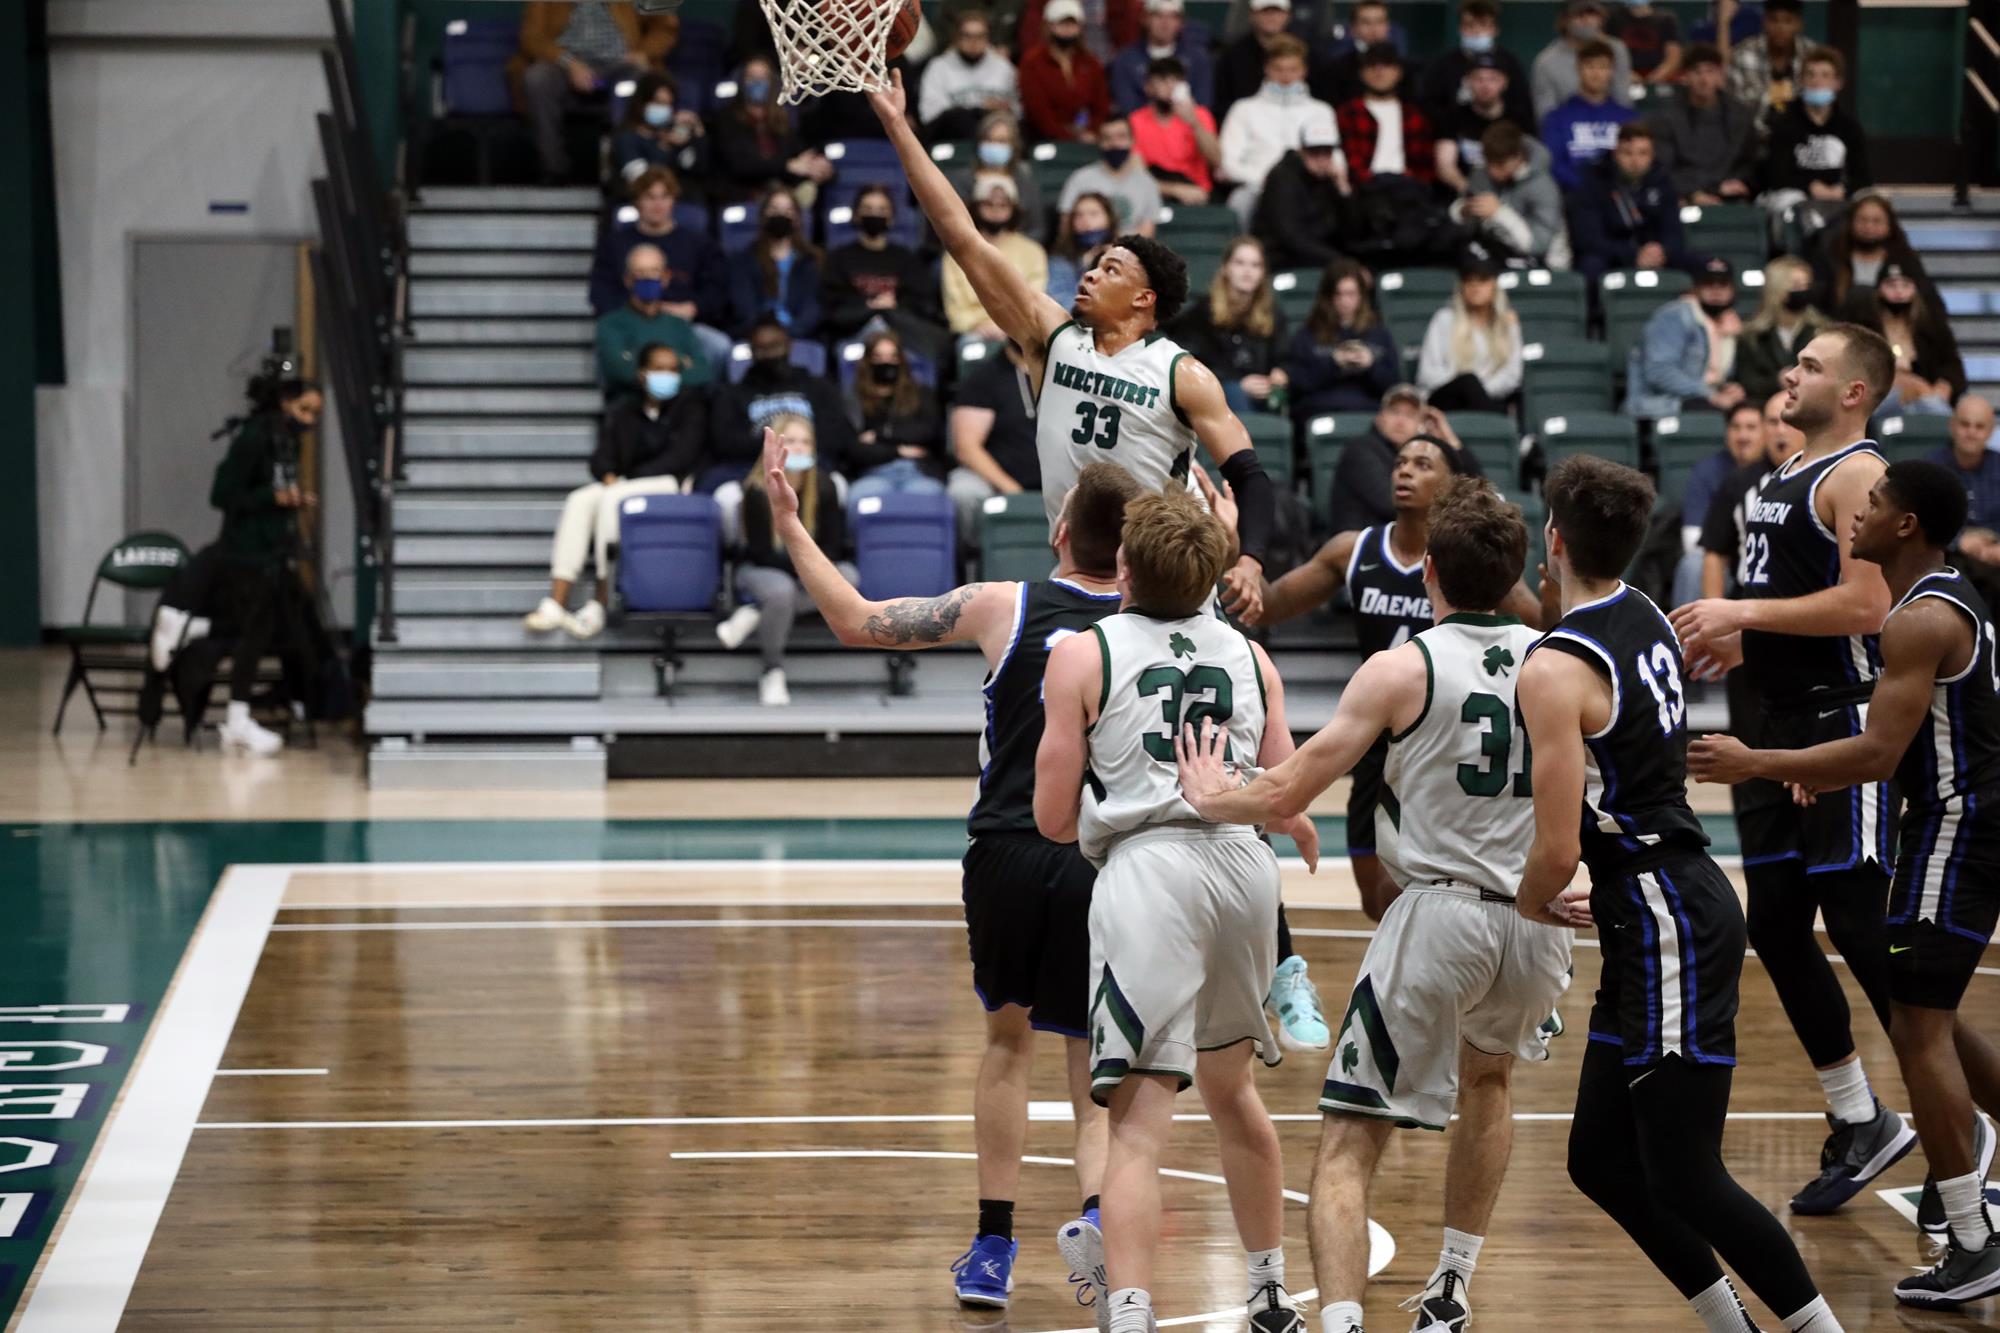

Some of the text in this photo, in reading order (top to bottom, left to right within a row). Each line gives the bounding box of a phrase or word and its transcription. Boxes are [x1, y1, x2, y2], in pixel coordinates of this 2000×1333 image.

[1053, 361, 1160, 409] MERCYHURST
[1071, 401, 1121, 449] 33
[1745, 532, 1769, 583] 22
[1360, 587, 1434, 619] DAEME
[1637, 641, 1685, 735] 13
[1136, 664, 1234, 763] 32
